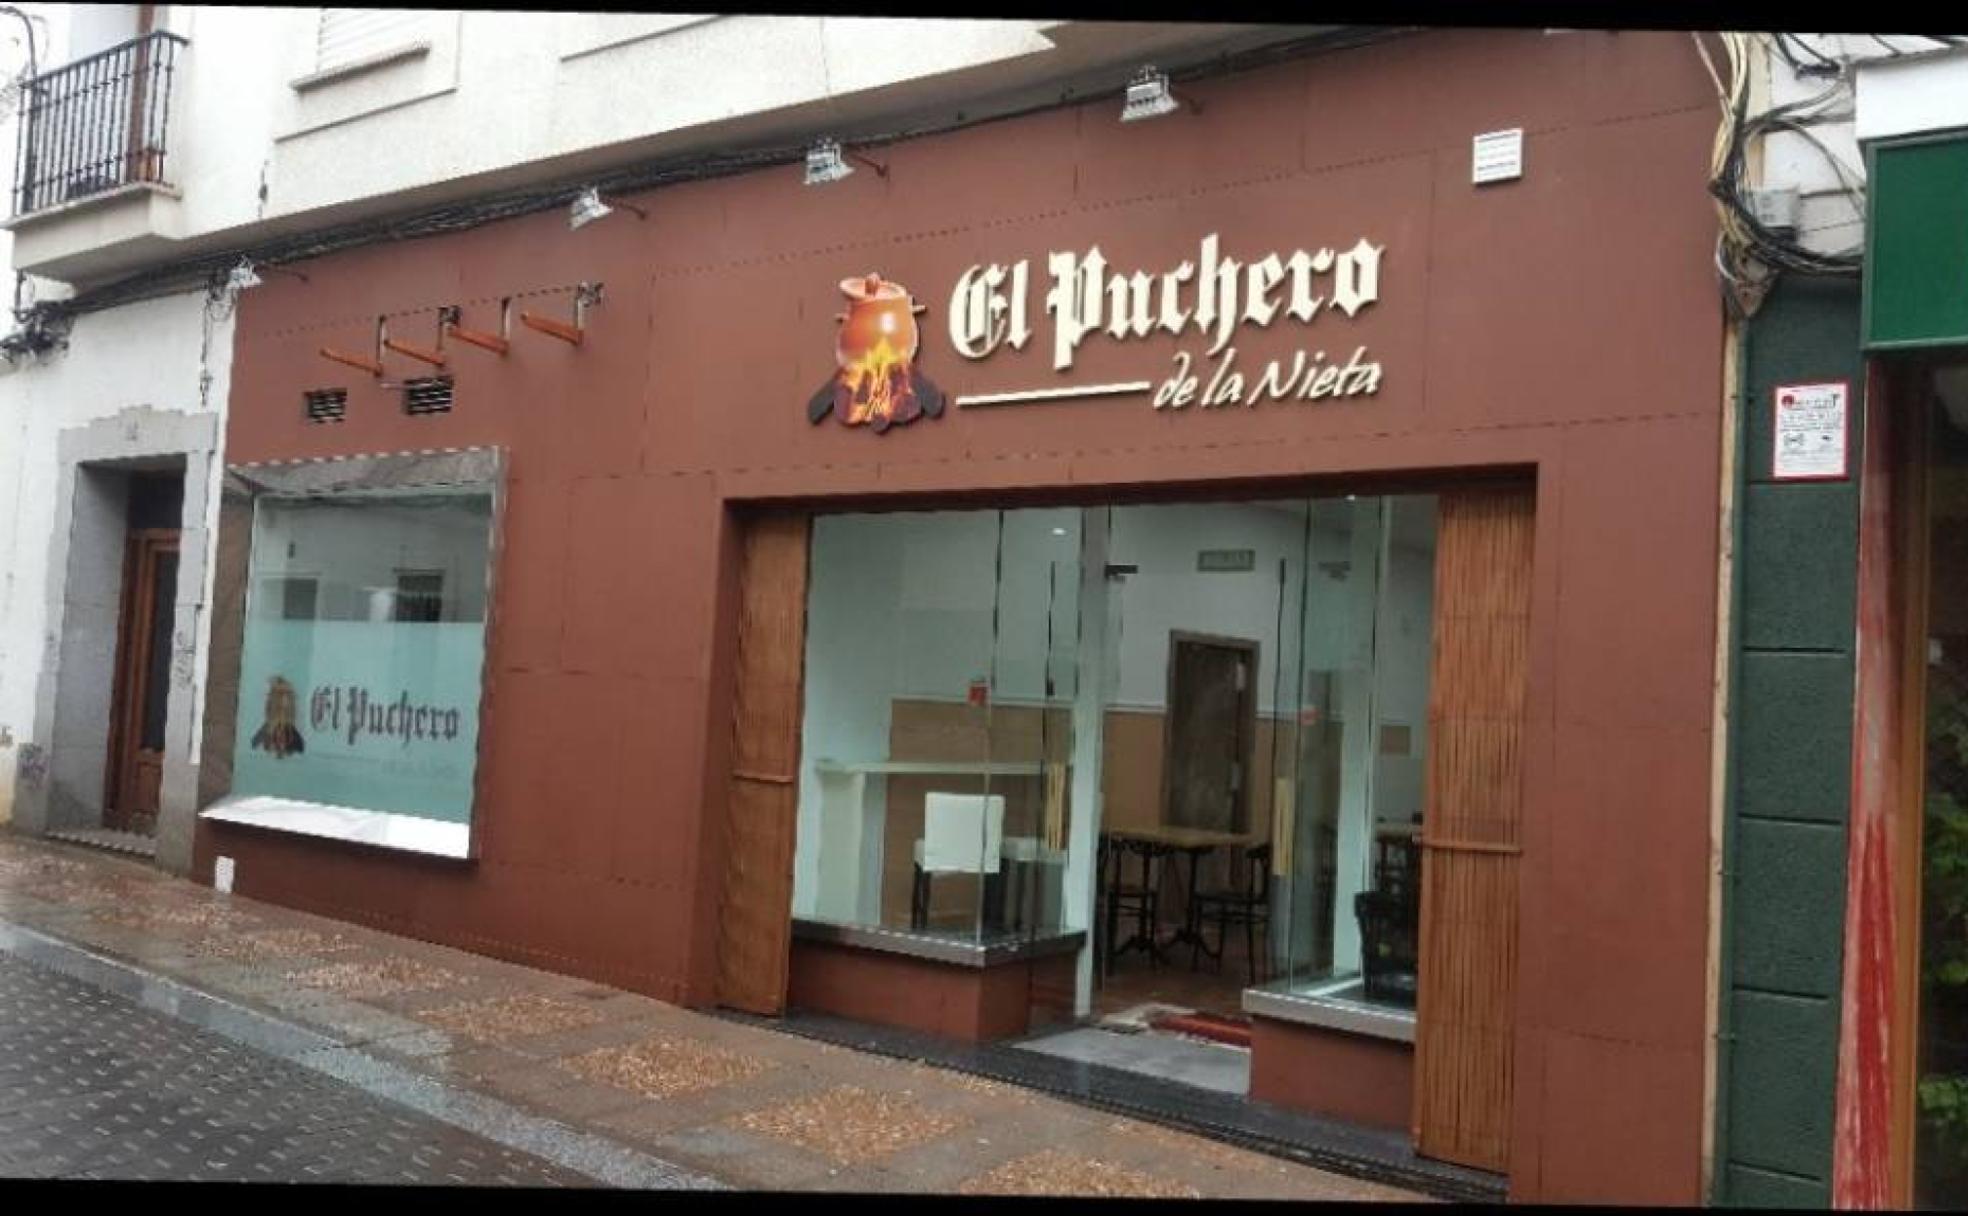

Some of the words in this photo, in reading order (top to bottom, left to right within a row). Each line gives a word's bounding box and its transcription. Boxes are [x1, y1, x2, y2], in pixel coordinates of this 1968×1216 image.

[948, 260, 1031, 360] El
[1046, 232, 1385, 370] Puchero
[1152, 351, 1199, 409] de
[1200, 348, 1244, 408] la
[1245, 345, 1382, 407] Nieta
[310, 685, 342, 731] El
[347, 685, 460, 746] Puchero
